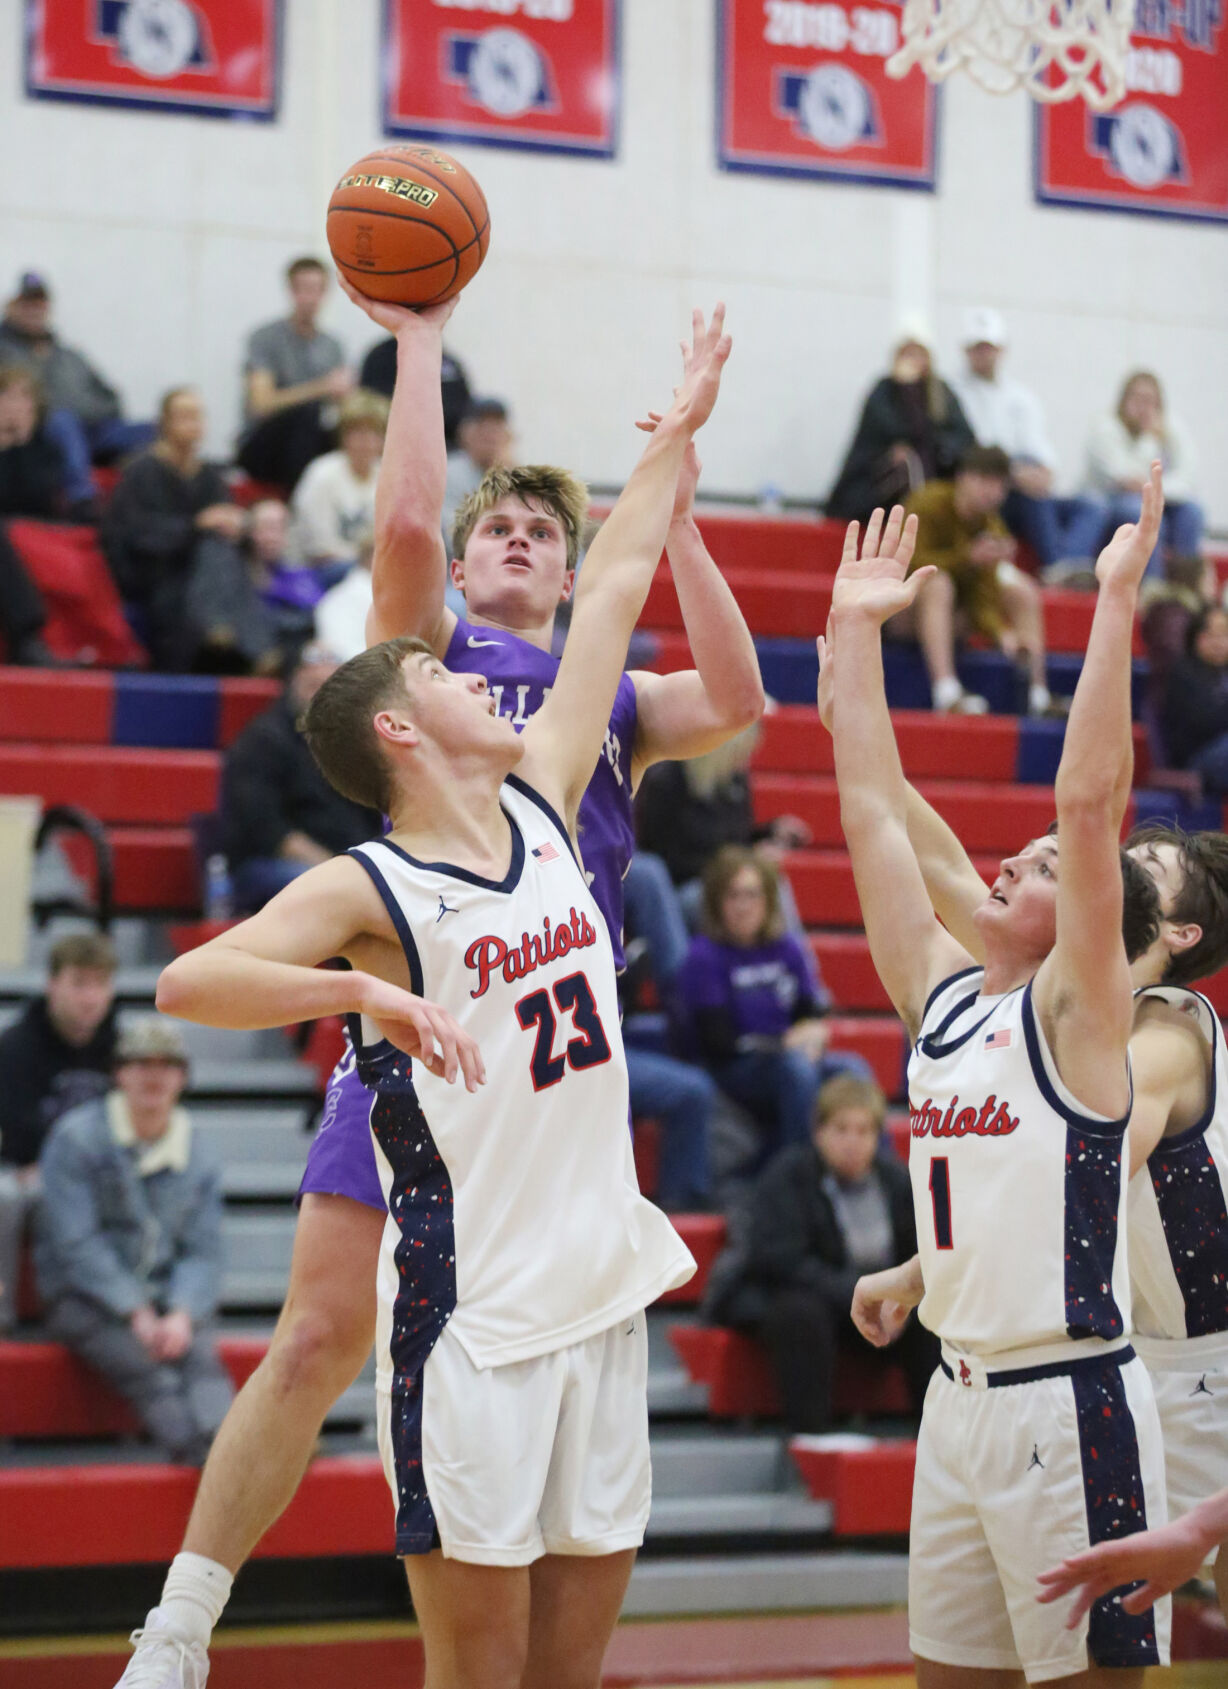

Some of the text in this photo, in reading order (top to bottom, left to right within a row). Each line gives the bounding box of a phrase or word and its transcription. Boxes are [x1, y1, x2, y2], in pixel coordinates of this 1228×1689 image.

[395, 180, 438, 208] PRO
[464, 906, 596, 999] Patriots
[514, 970, 611, 1093] 23
[909, 1094, 1020, 1138] atriots
[928, 1156, 954, 1250] 1
